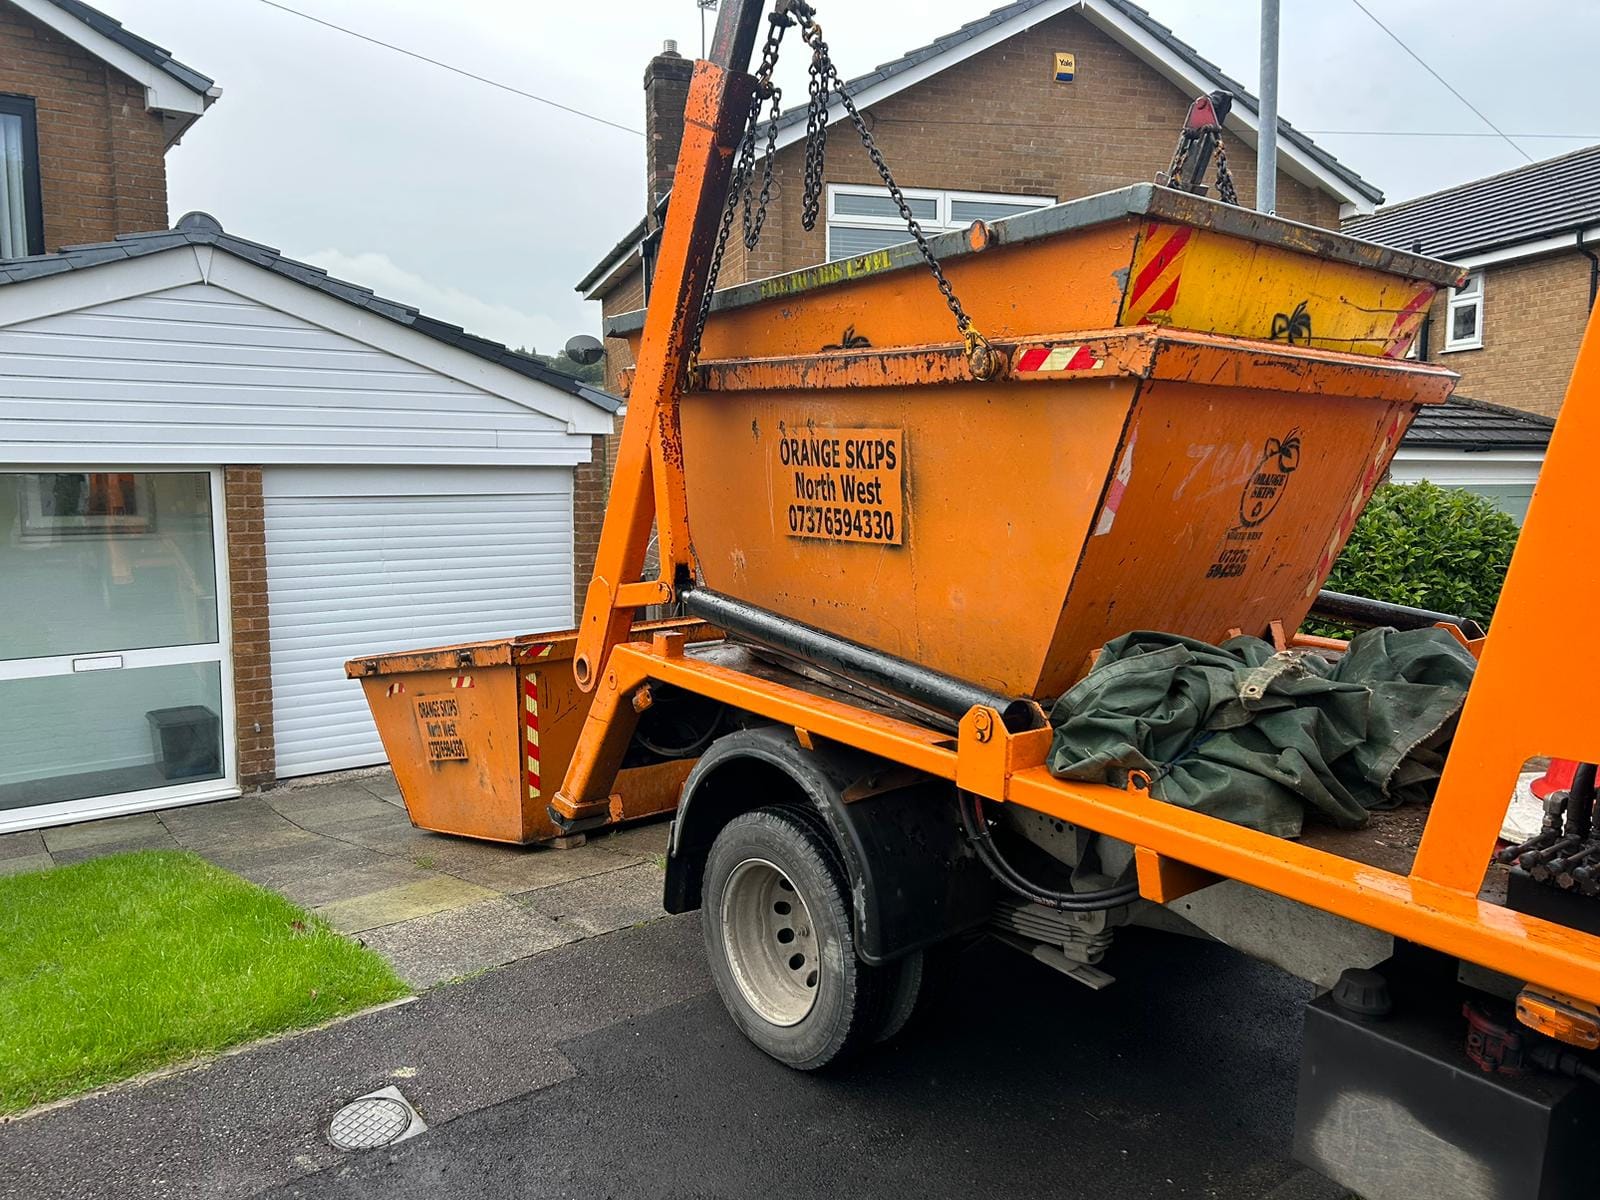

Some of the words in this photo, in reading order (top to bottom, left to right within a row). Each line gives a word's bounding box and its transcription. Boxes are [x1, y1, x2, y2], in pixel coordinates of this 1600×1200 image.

[1059, 59, 1073, 67] Yale
[780, 438, 841, 468] ORANGE
[845, 440, 897, 470] SKIPS
[795, 472, 836, 502] North
[840, 474, 882, 505] West
[1253, 473, 1286, 486] ORANGE
[788, 504, 894, 541] 07376594330
